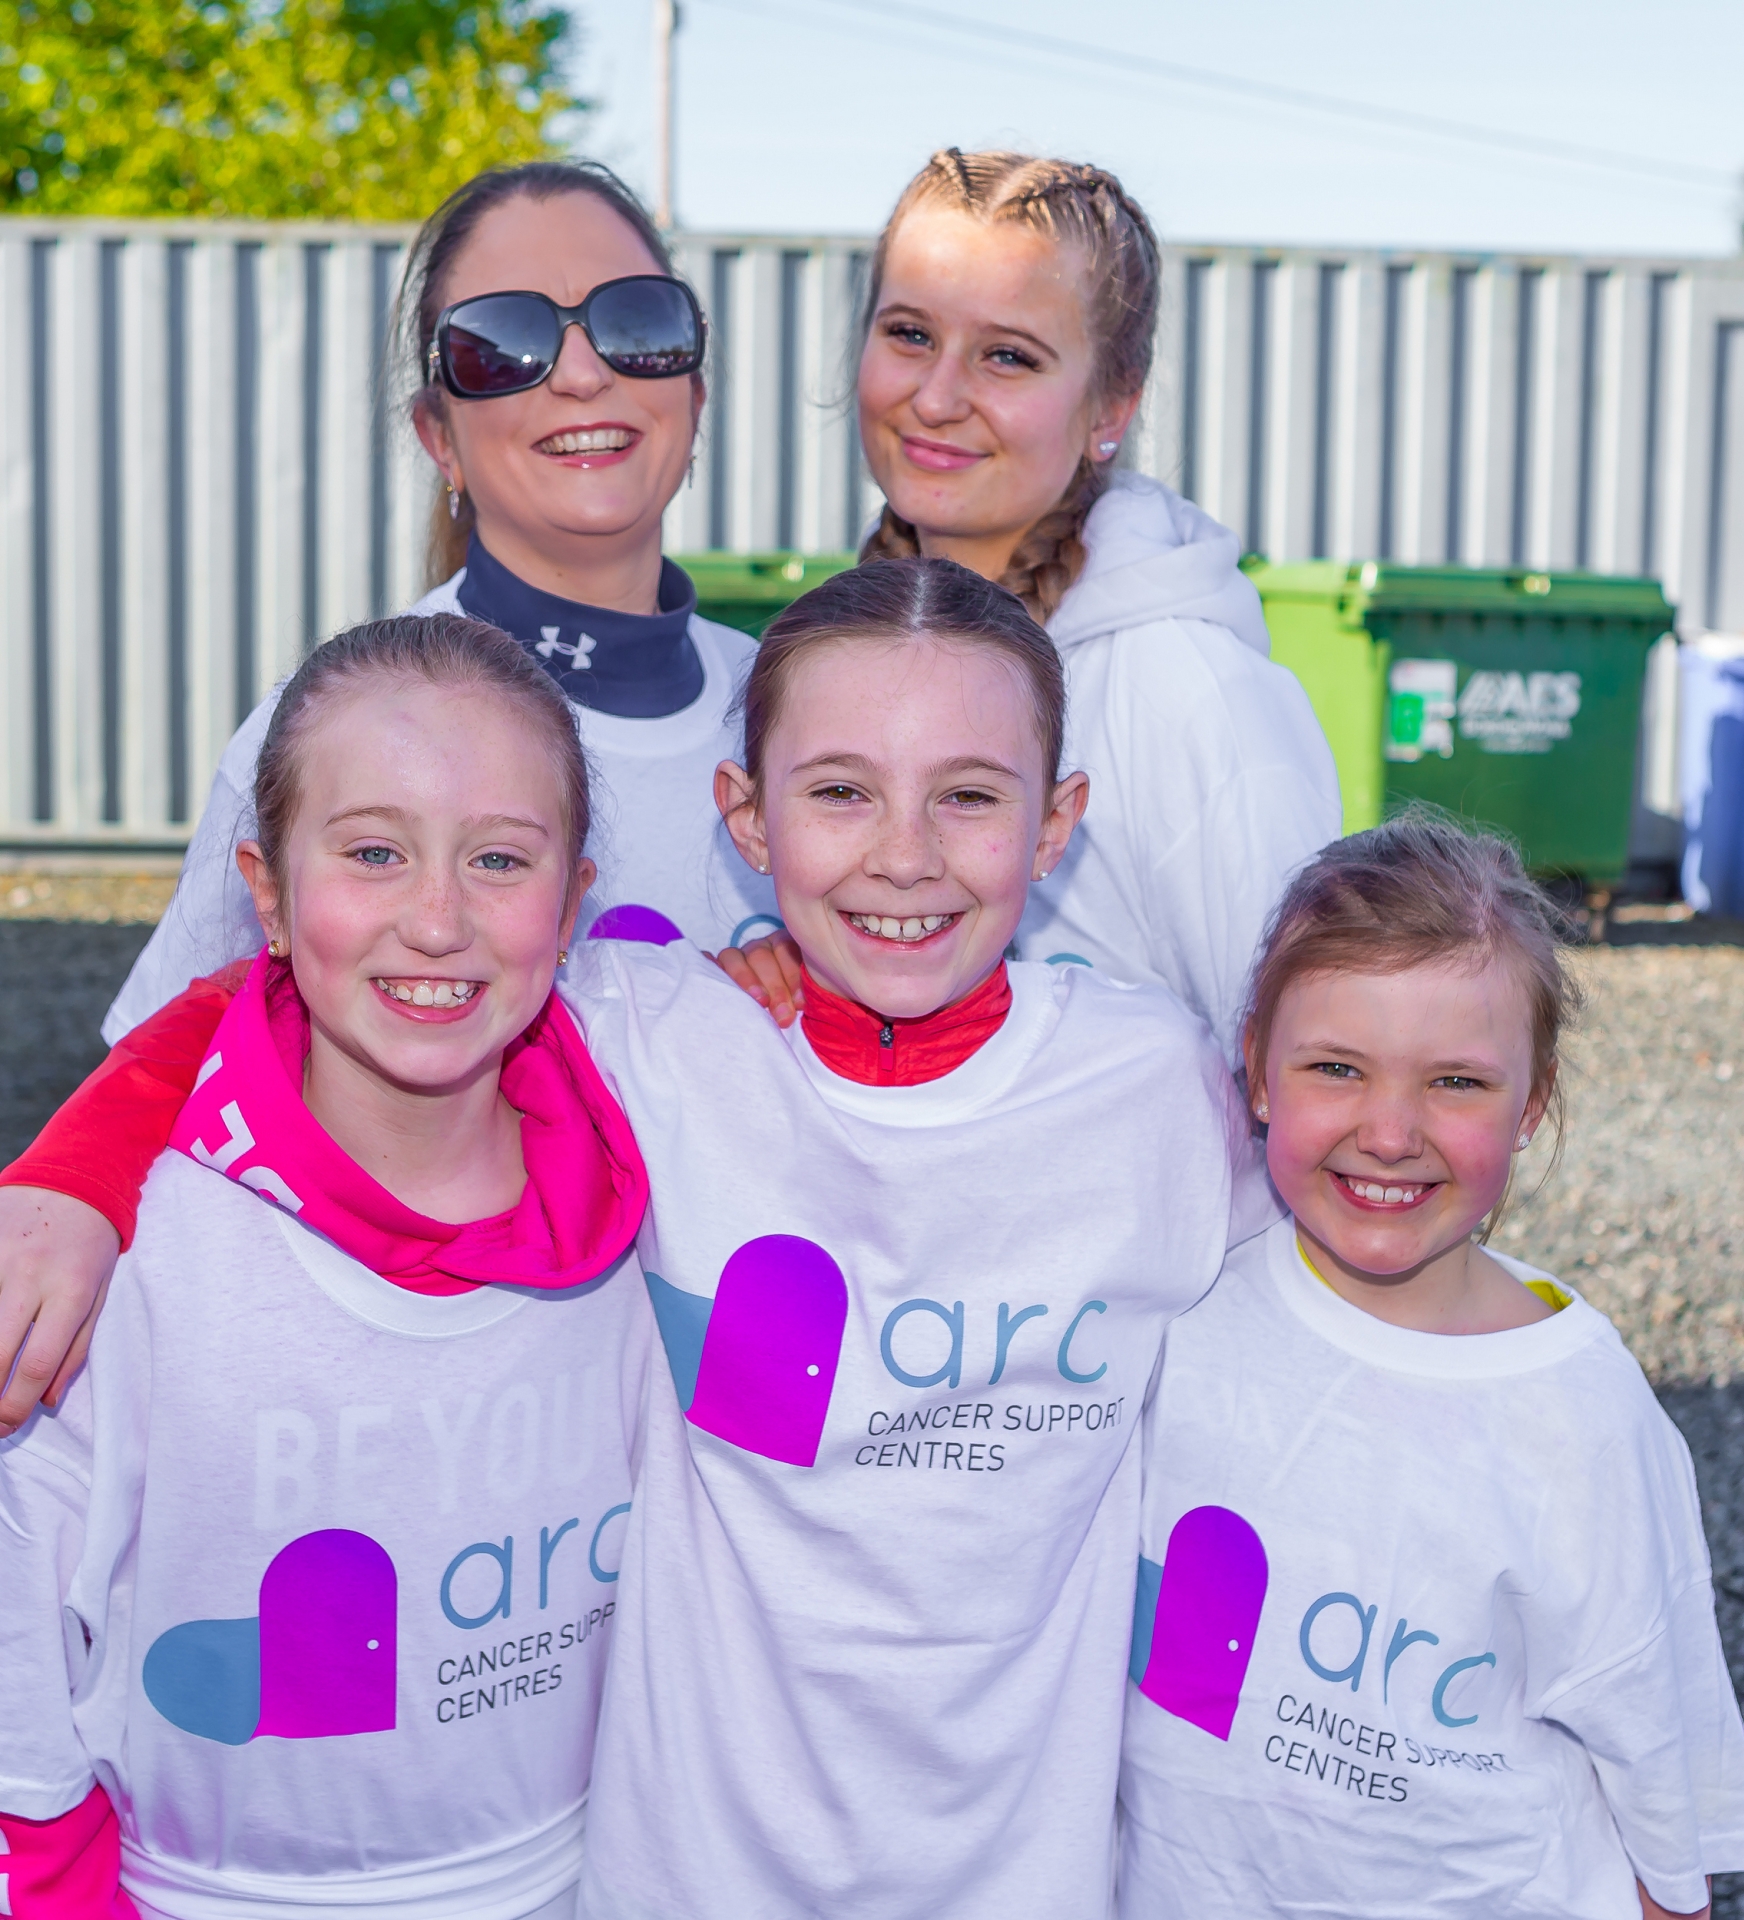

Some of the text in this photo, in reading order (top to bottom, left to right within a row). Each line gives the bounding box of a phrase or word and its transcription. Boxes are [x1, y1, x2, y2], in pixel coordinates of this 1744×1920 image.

[879, 1297, 1108, 1390] arc
[254, 1365, 601, 1530] BE YOU
[855, 1441, 1006, 1473] CENTRES
[867, 1396, 1126, 1437] CANCER SUPPORT
[439, 1501, 633, 1630] arc
[436, 1601, 616, 1686] CANCER SUPP
[1299, 1591, 1497, 1729] arc
[435, 1662, 564, 1724] CENTRES
[1276, 1693, 1515, 1775] CANCER SUPPORT
[1264, 1734, 1410, 1803] CENTRES
